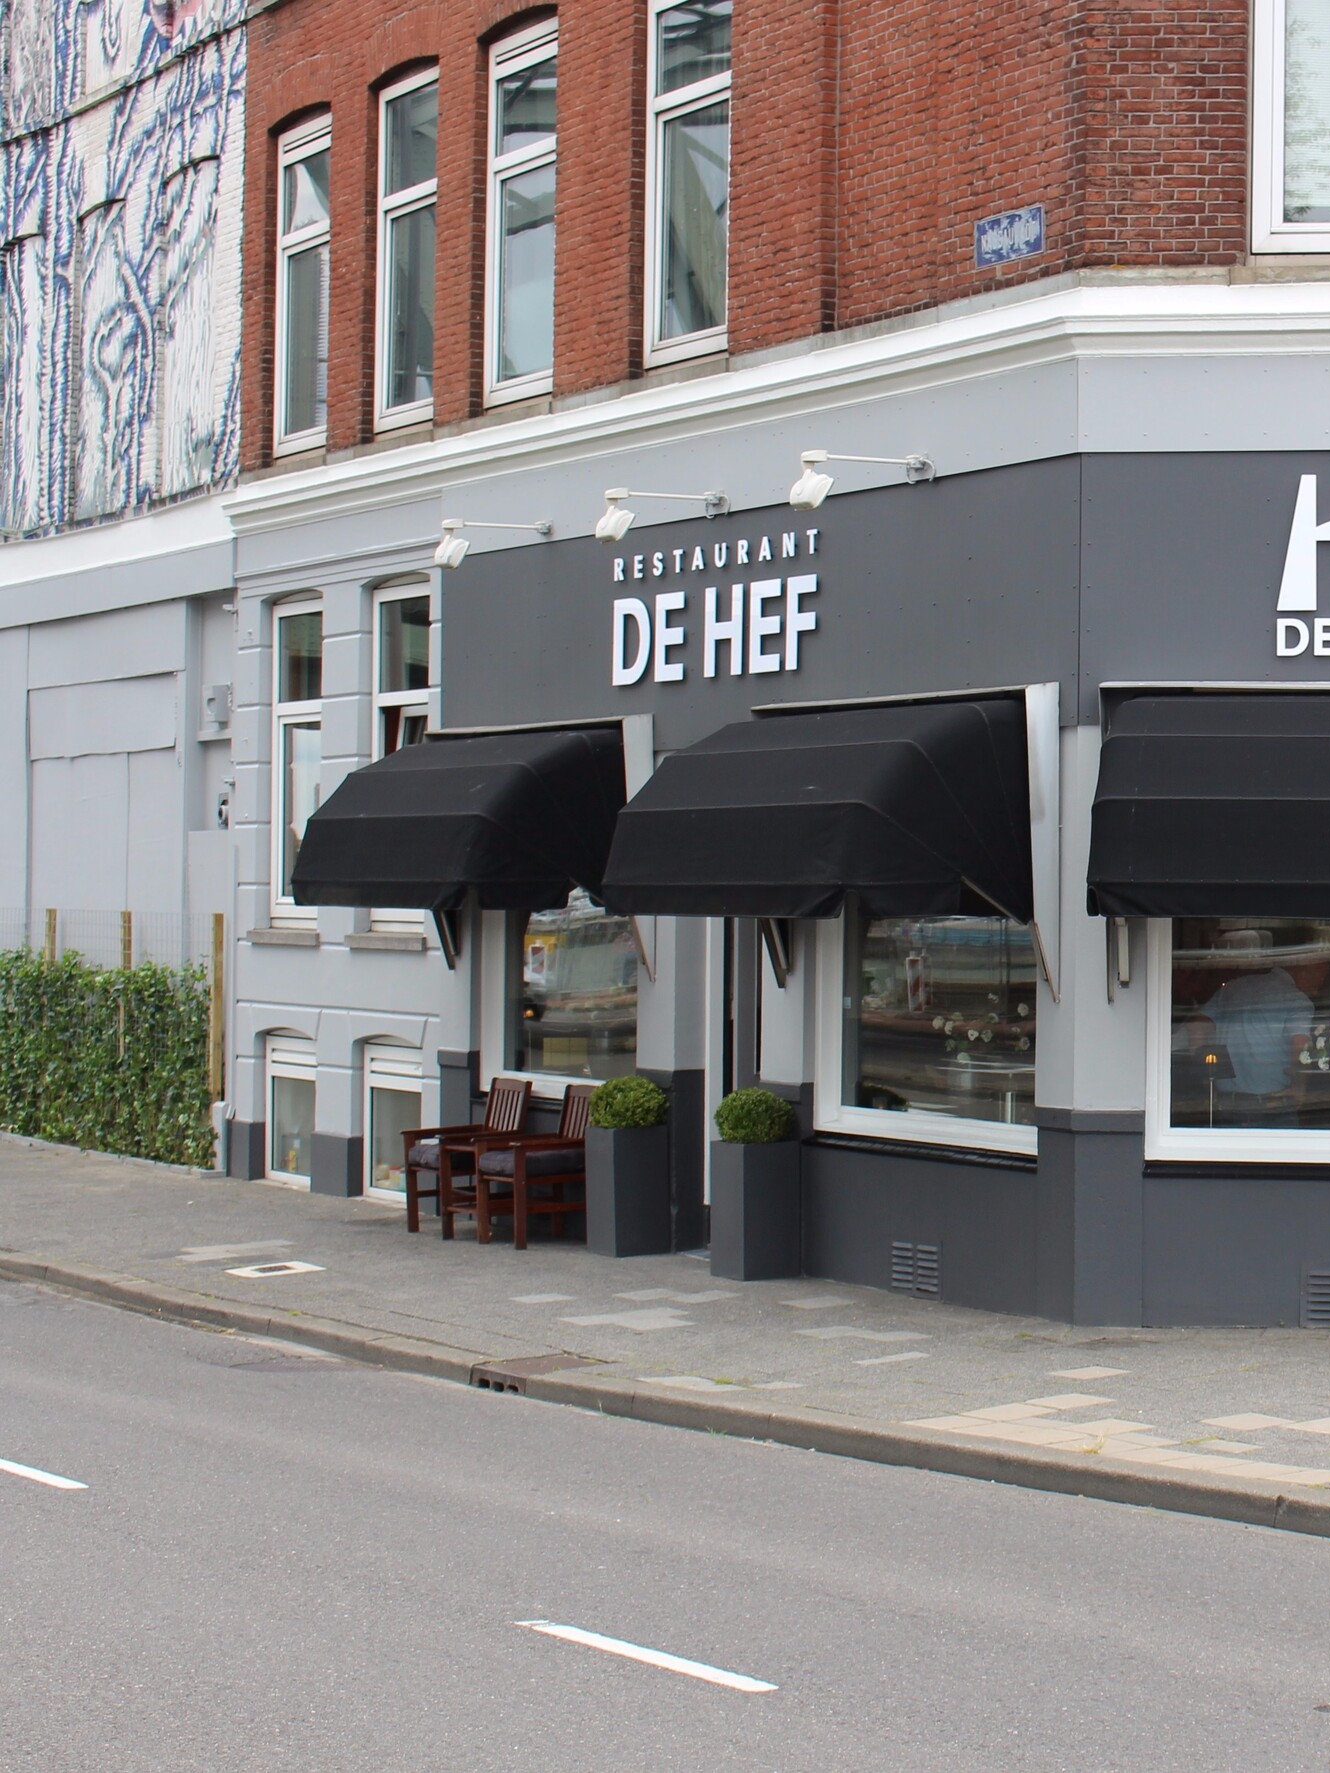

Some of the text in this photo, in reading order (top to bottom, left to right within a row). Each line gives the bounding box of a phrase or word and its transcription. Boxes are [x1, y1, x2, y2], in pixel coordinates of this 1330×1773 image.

[613, 528, 819, 582] RESTAURANT
[611, 573, 818, 687] DE HEF
